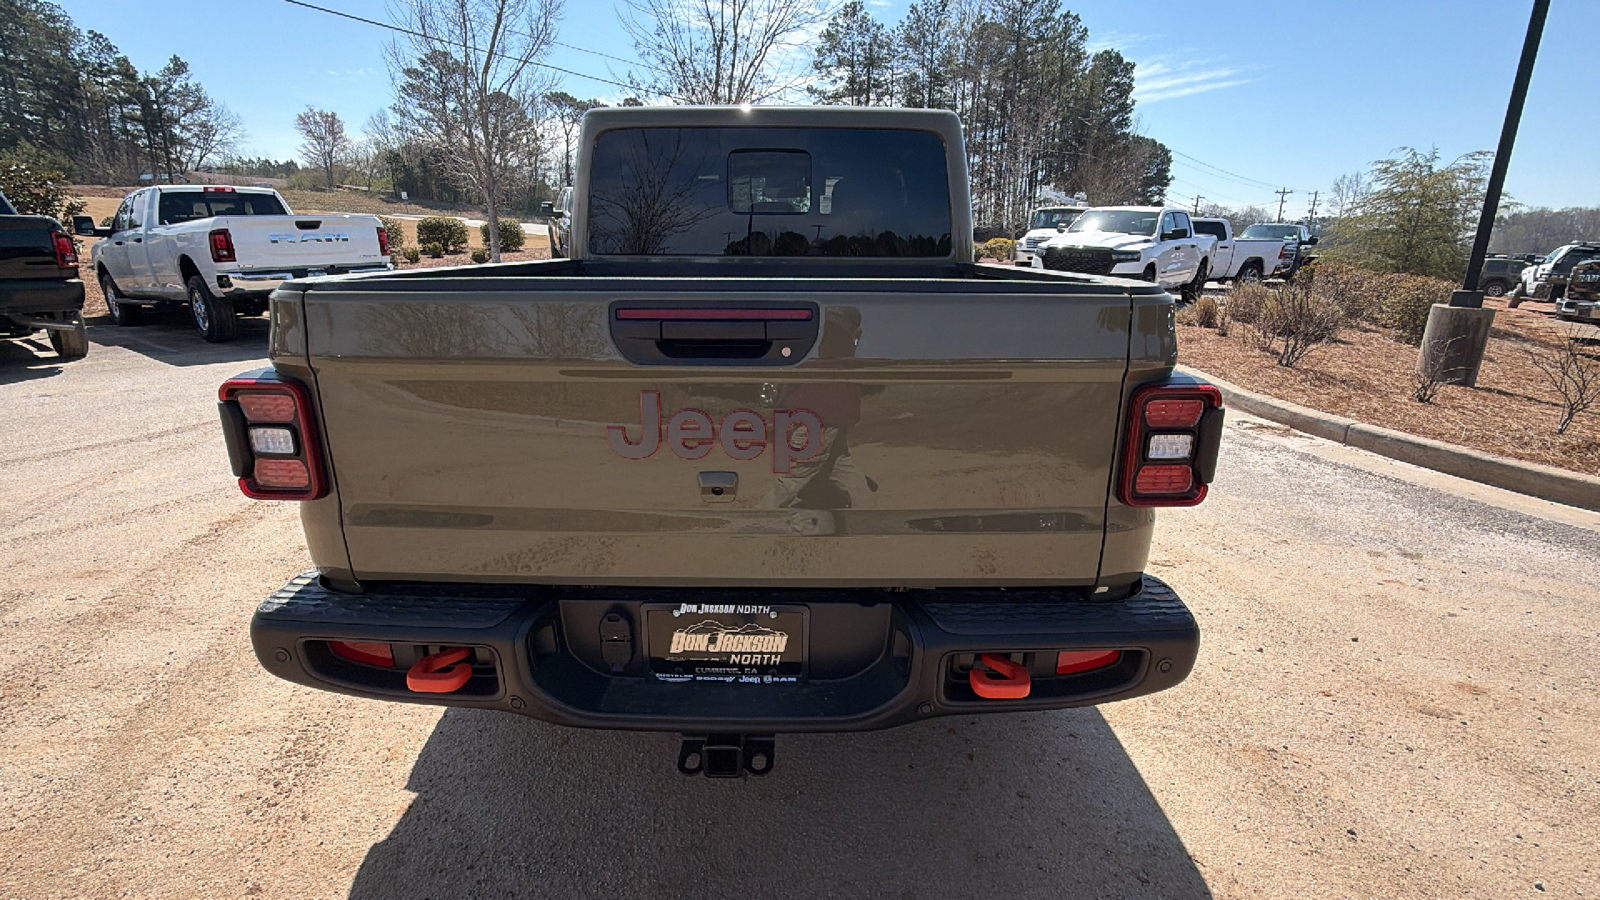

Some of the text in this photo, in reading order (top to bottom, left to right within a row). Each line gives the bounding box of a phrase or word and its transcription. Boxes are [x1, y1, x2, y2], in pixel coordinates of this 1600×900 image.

[269, 232, 349, 244] RAM
[606, 389, 824, 474] Jeep
[736, 605, 771, 614] NORTH
[708, 632, 788, 653] JACKSON
[729, 654, 781, 666] NORTH
[738, 675, 761, 684] Jeep
